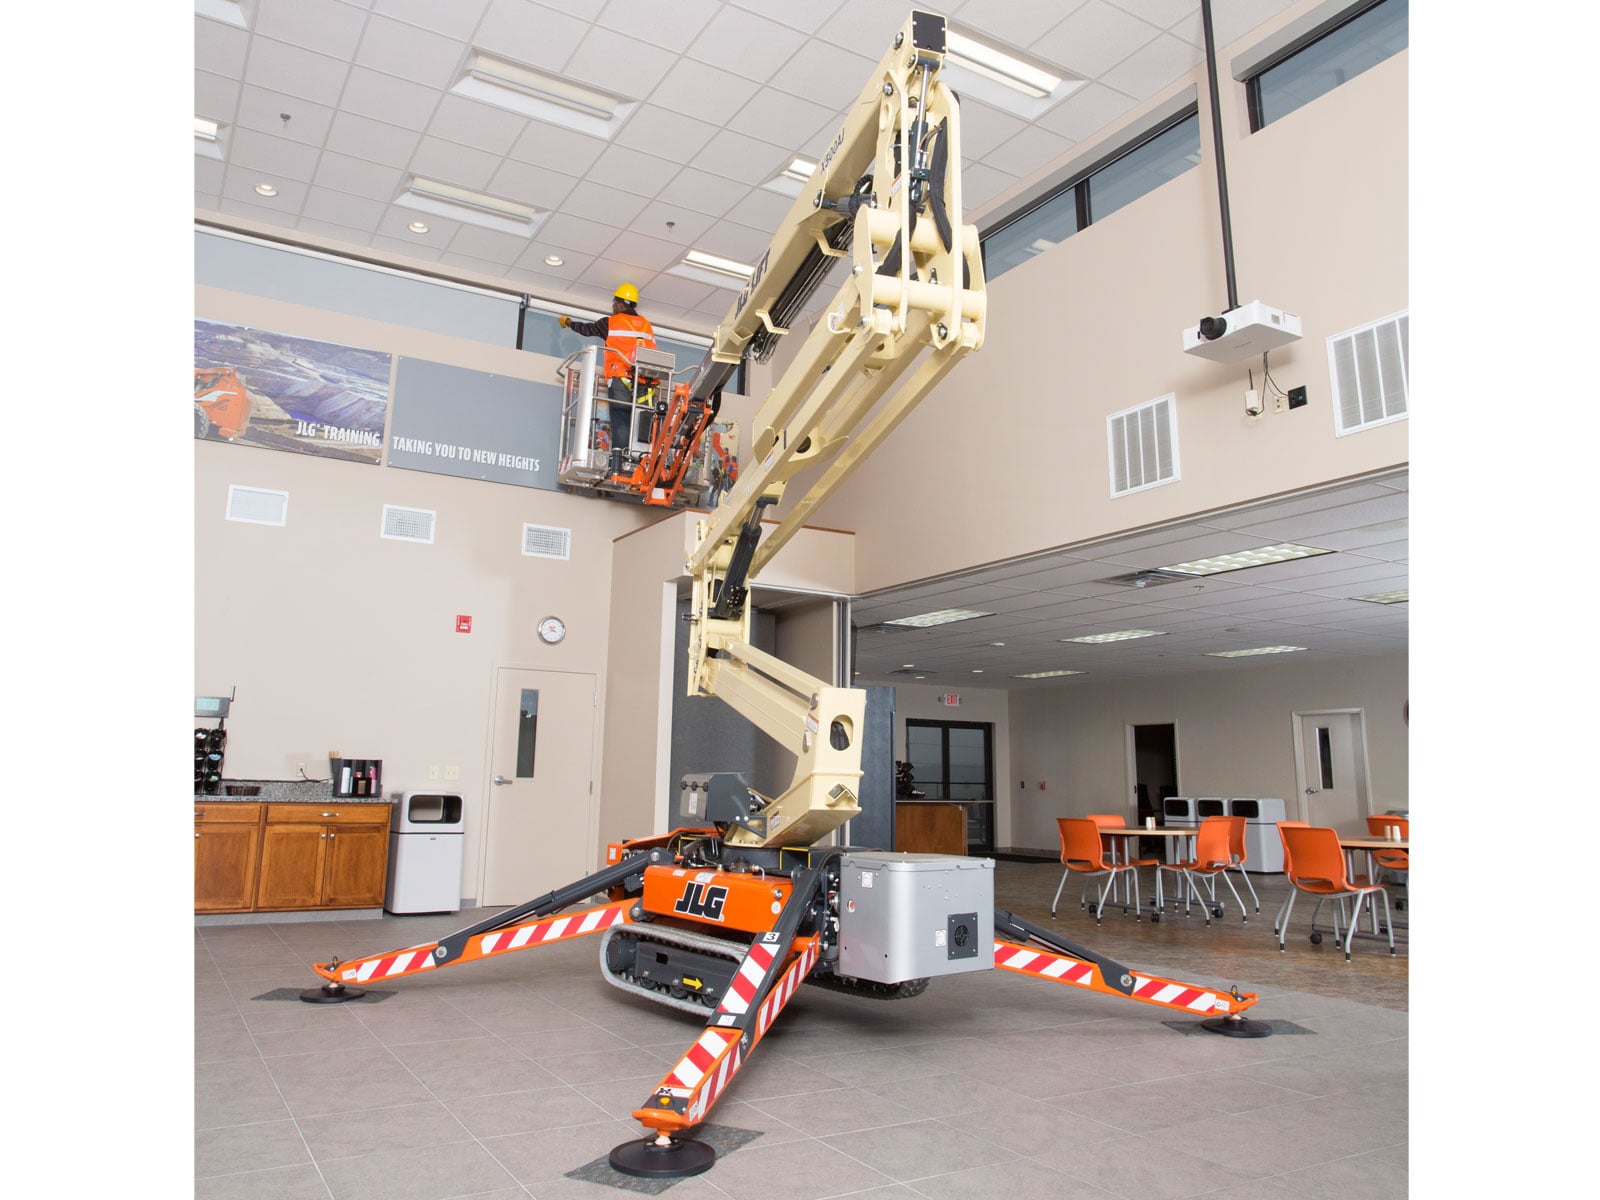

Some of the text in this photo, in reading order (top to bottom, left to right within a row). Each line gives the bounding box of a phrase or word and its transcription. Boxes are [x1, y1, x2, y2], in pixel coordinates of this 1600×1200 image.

[323, 425, 381, 447] TRAINING
[392, 436, 541, 472] TAKING YOU TO NEW HEIGHTS
